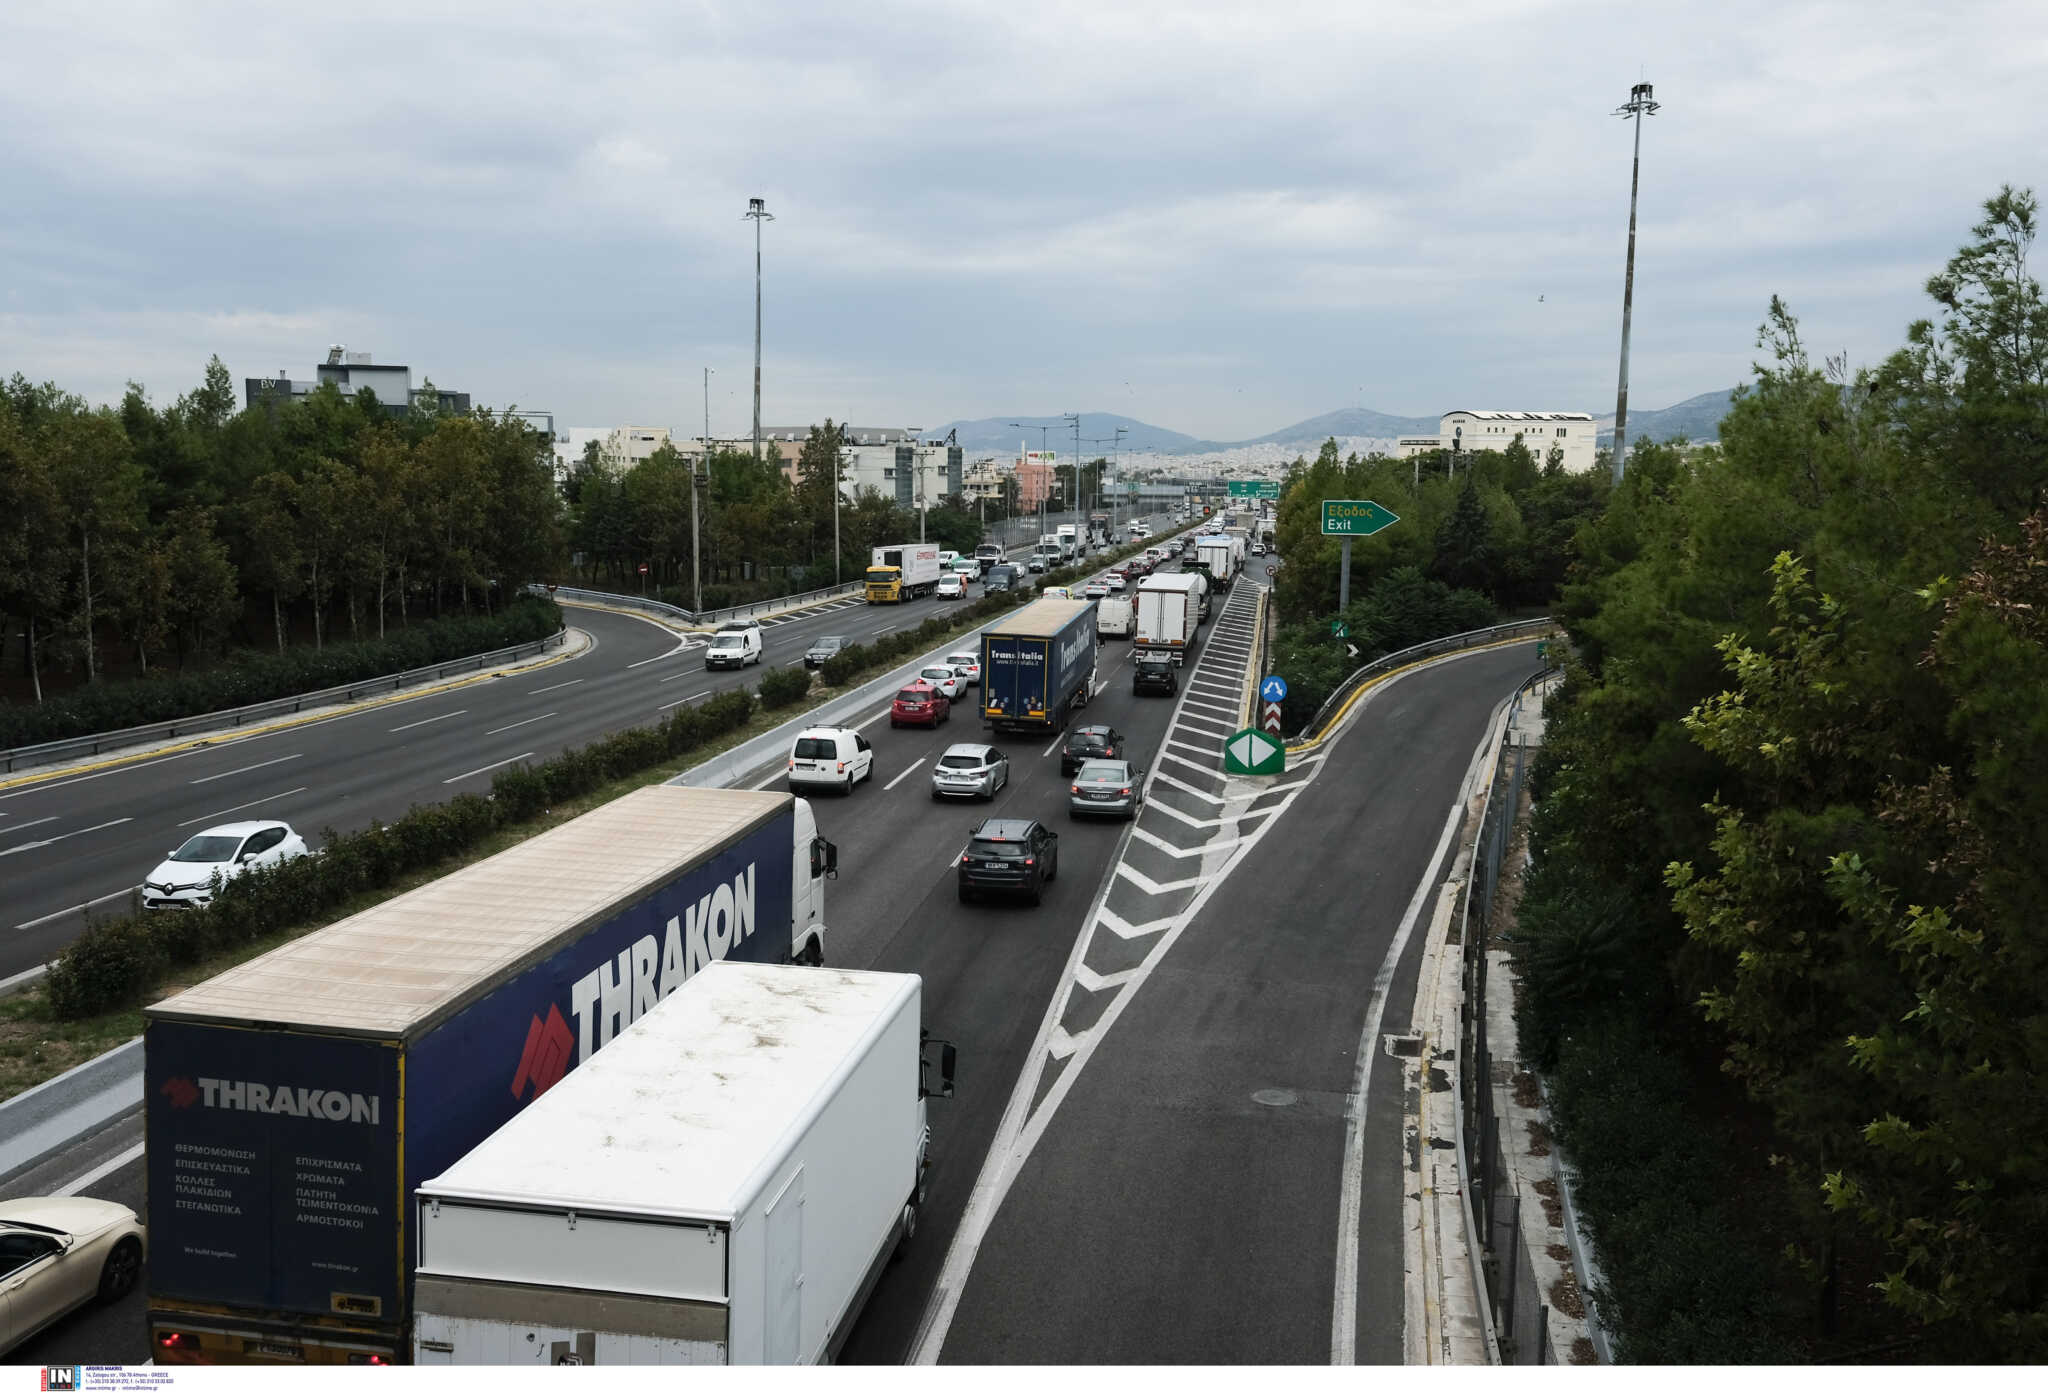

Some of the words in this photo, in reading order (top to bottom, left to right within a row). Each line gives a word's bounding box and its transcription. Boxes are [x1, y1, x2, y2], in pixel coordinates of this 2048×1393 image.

[1328, 519, 1351, 530] Exit
[572, 862, 755, 1066] THRAKON
[198, 1077, 379, 1125] THRAKON
[175, 1143, 256, 1160] ΘΕΡΜΟΜΟΝΩΣΗ
[175, 1159, 250, 1175] ΕΠΙΣΚΕΥΑΣΤΙΚΑ
[296, 1156, 362, 1172] ΕΠΙΧΡΙΣΜΑΤΑ
[175, 1174, 216, 1187] ΚΟΛΛΕΣ
[296, 1173, 345, 1186] ΧΡΩΜΑΤΑ
[175, 1185, 232, 1199] ΠΛΑΚΙΔΙΩΝ
[296, 1187, 336, 1201] ΠΑΤΗΤΗ
[175, 1200, 241, 1215] ΣΤΕΓΑΝΩΤΙΚΑ
[296, 1213, 364, 1229] ΑΡΜΟΣΤΟΚΟΙ
